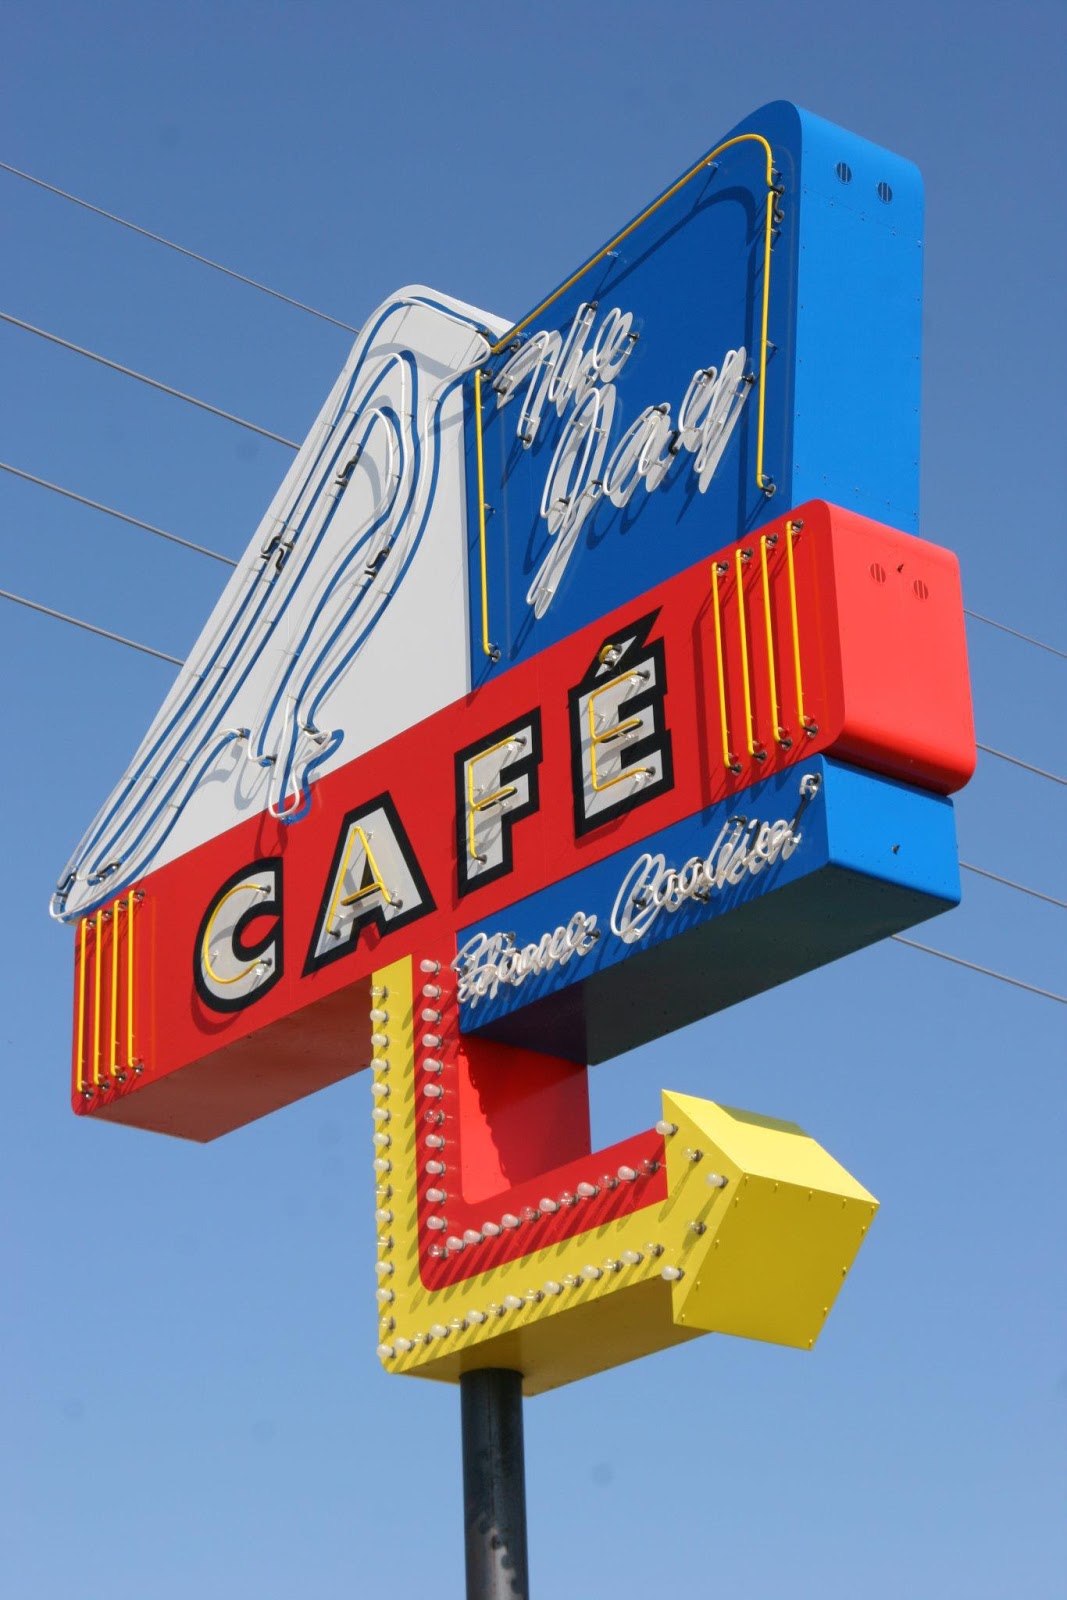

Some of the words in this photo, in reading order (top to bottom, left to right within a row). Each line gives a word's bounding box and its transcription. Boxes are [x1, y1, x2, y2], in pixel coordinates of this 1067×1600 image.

[492, 301, 639, 450] The
[526, 347, 755, 620] Jay
[193, 606, 675, 1013] CAFÉ
[450, 911, 601, 1009] Home
